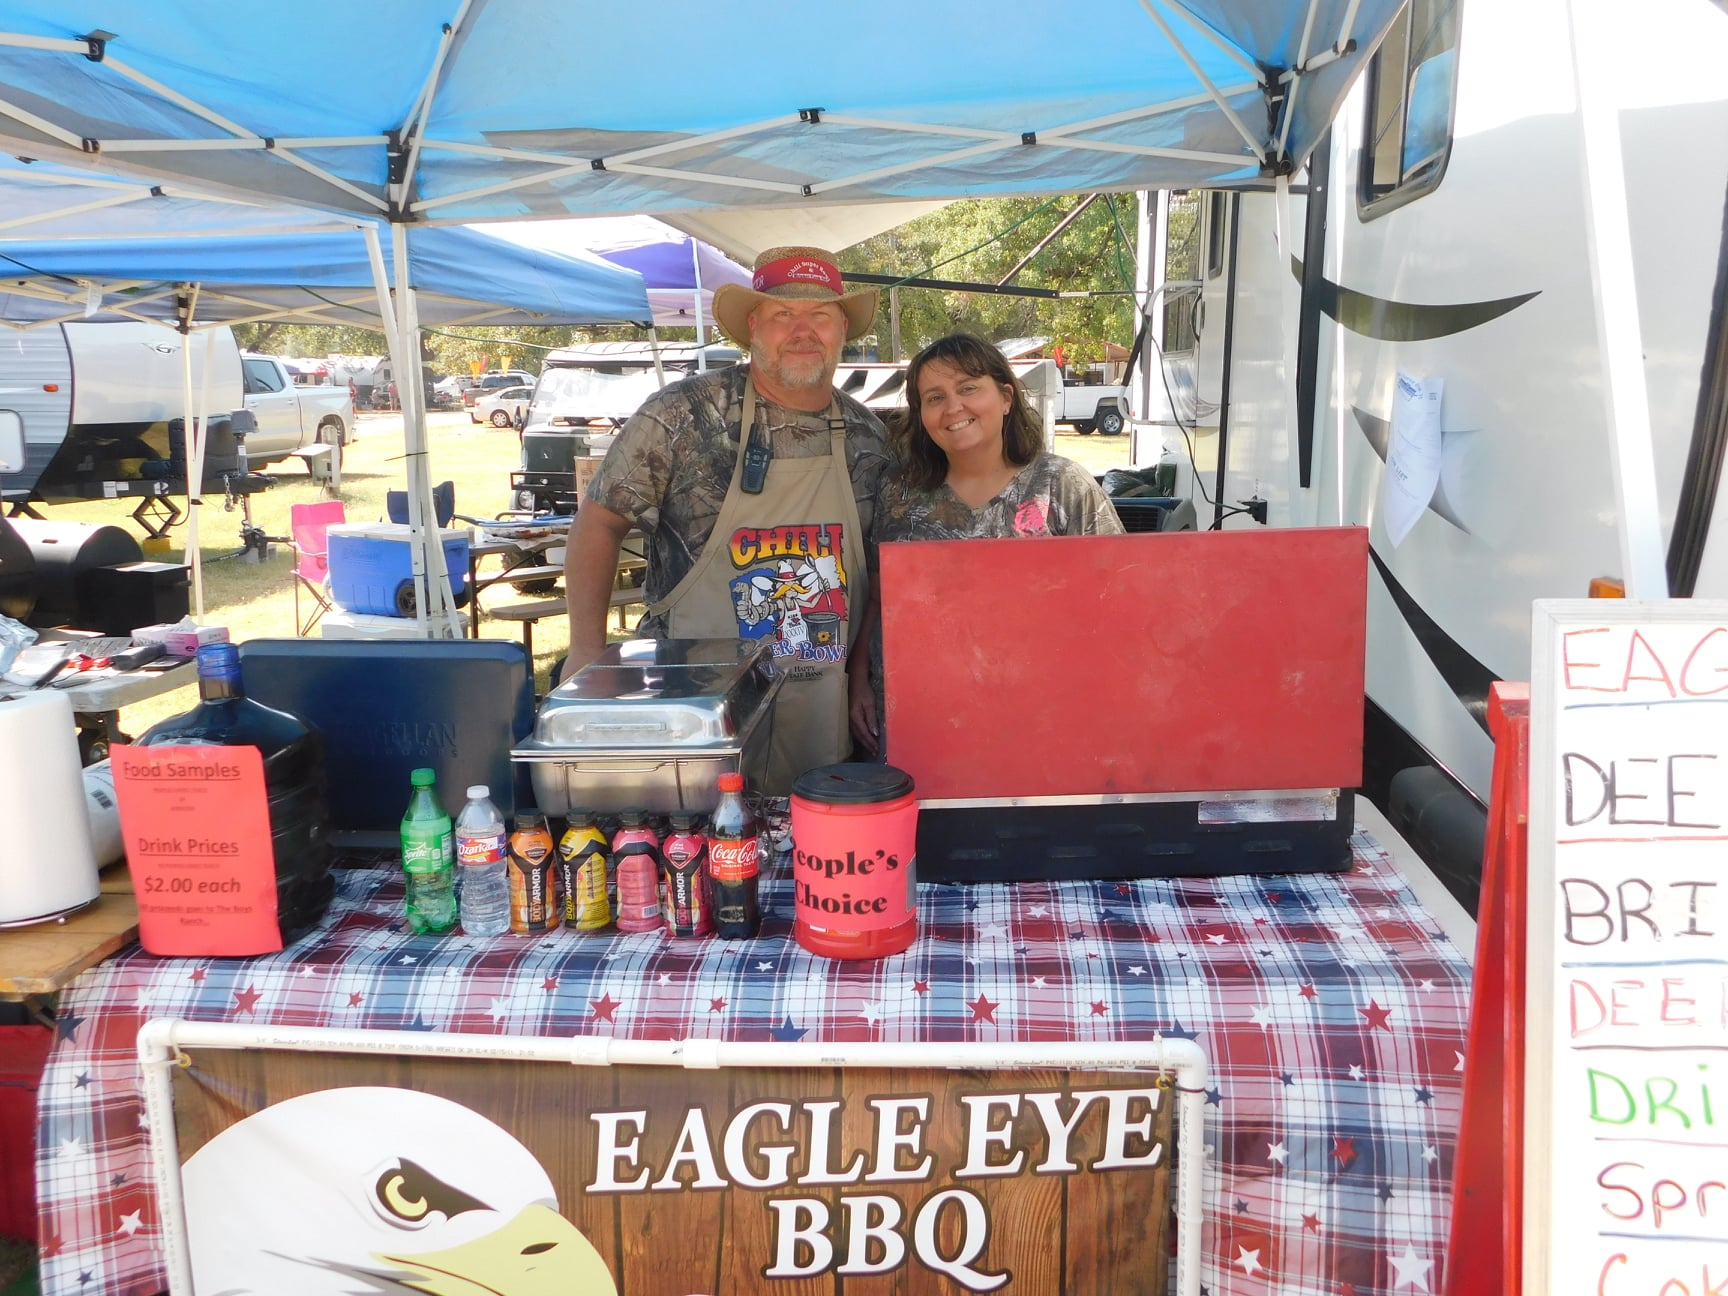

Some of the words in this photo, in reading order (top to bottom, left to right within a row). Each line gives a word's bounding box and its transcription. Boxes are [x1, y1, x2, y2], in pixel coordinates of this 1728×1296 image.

[729, 523, 848, 596] CHILI
[770, 638, 795, 658] ER
[1563, 627, 1728, 698] EAG
[123, 762, 161, 777] Food
[168, 762, 241, 780] Samples
[1563, 752, 1720, 829] DEE
[138, 838, 183, 853] Drink
[188, 839, 239, 854] Prices
[144, 876, 193, 893] $2.00
[198, 878, 241, 893] each
[795, 879, 888, 915] Choice
[1560, 877, 1718, 946] BRI
[585, 1097, 932, 1193] EAGLE
[955, 1088, 1163, 1176] EYE
[766, 1188, 1009, 1291] BBQ
